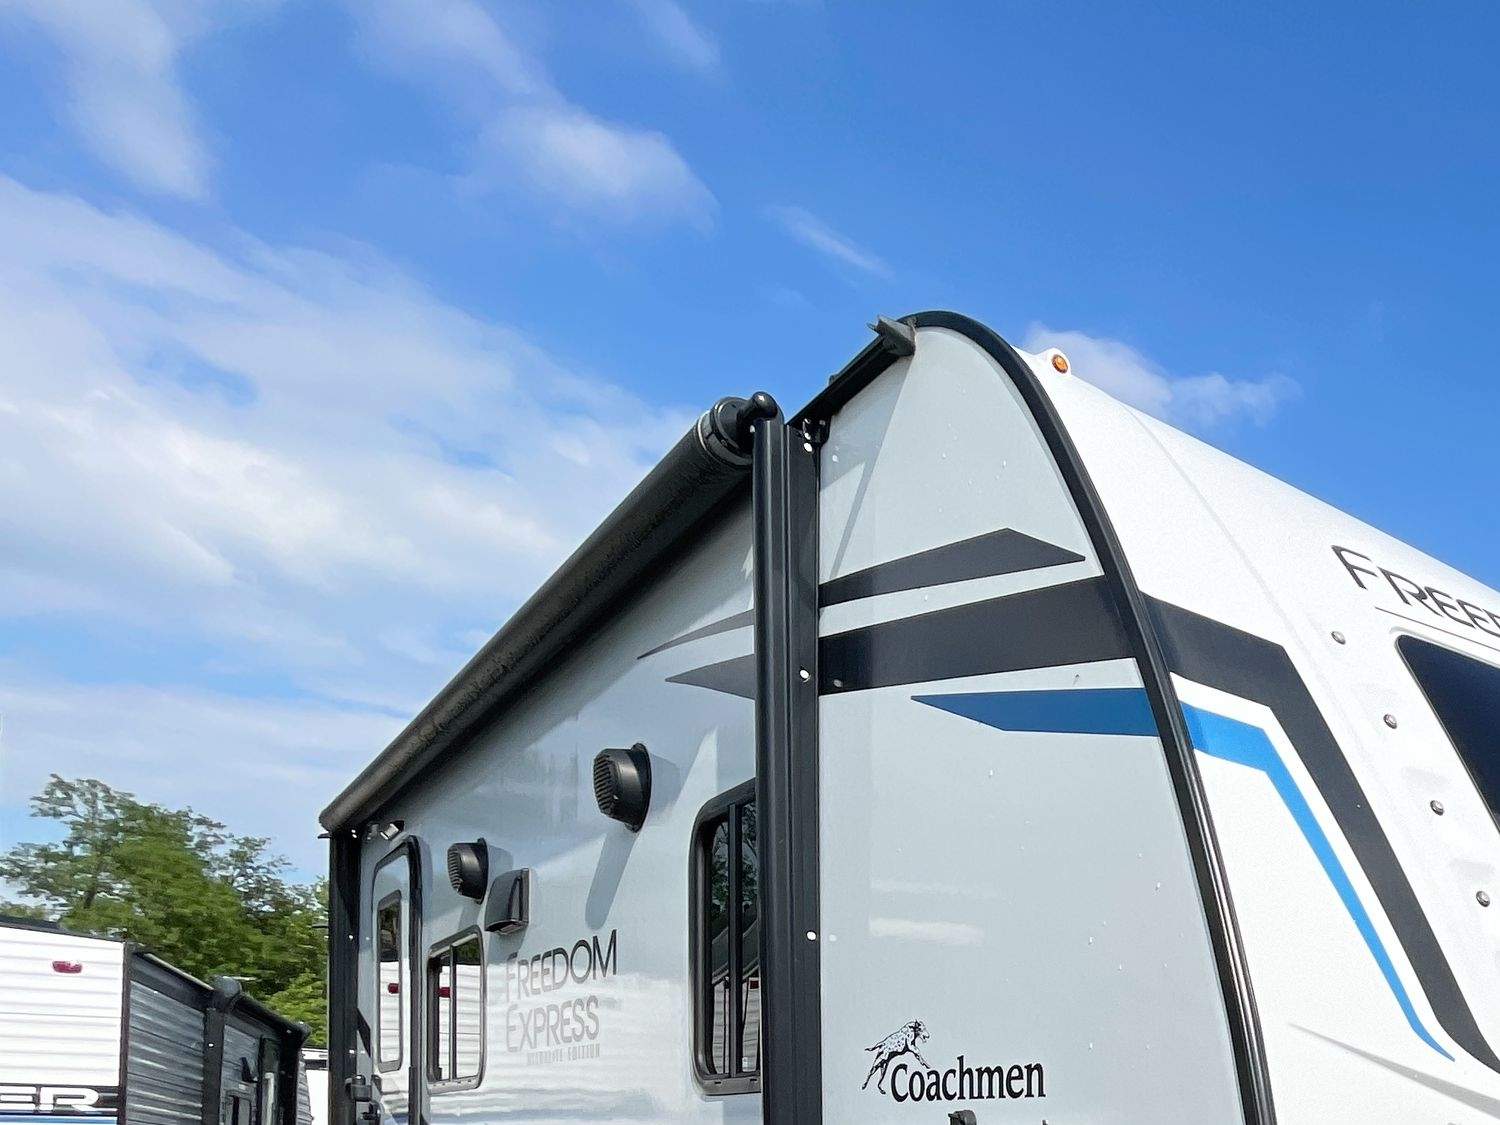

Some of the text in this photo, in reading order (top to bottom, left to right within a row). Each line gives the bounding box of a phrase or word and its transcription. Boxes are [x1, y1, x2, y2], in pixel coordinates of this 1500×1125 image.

[506, 929, 617, 1003] FREEDOM
[506, 995, 600, 1053] EXPRESS
[891, 1055, 1046, 1102] Coachmen
